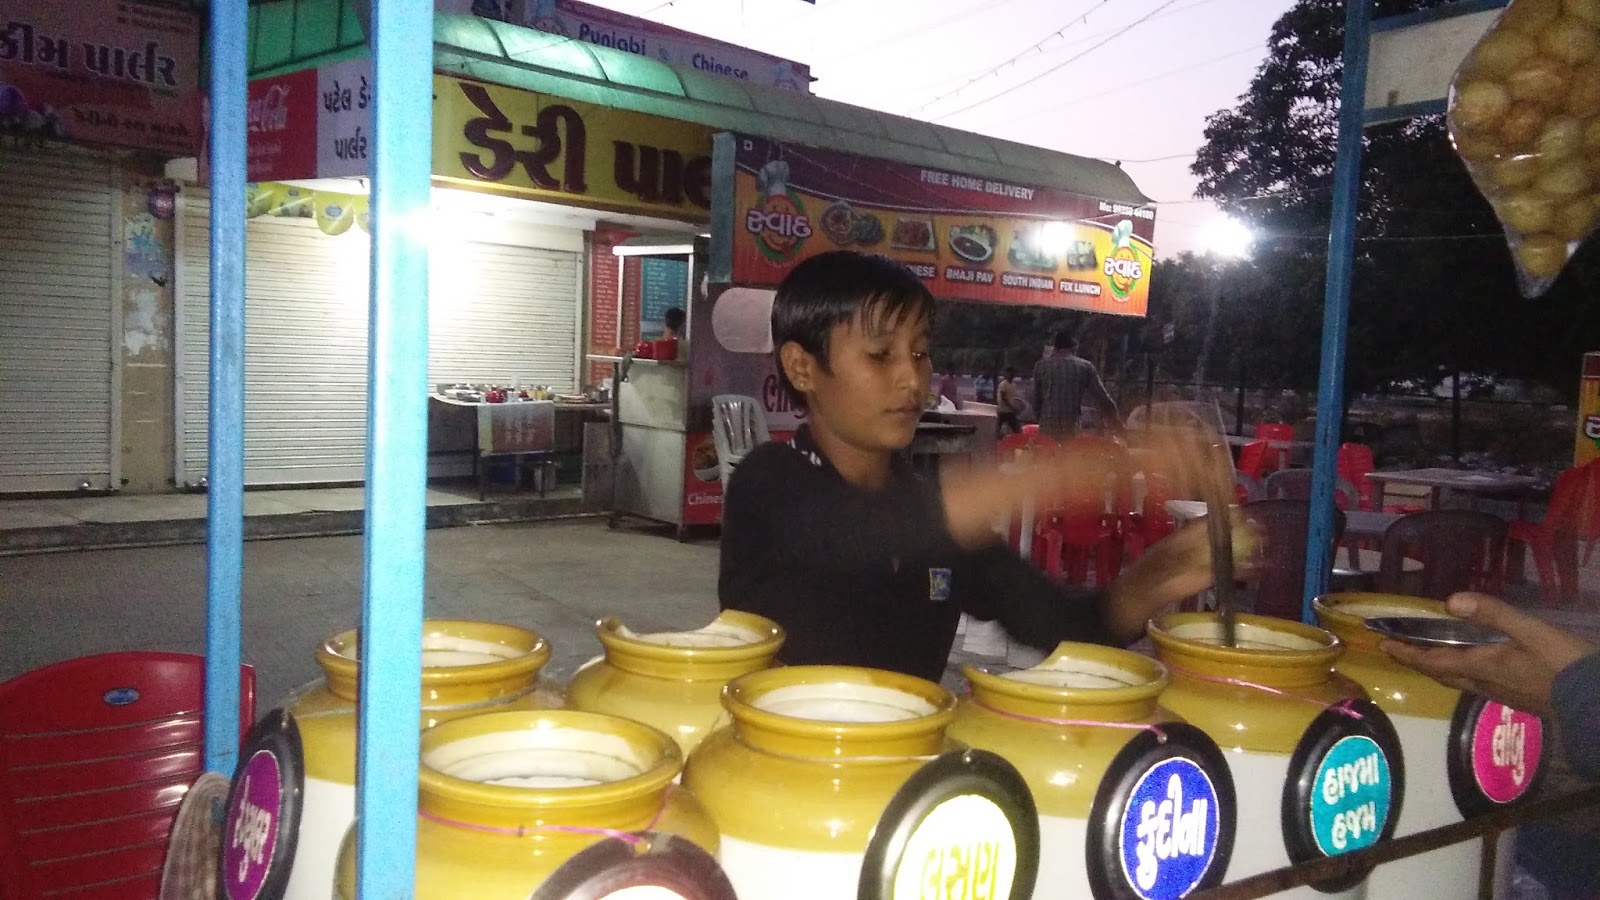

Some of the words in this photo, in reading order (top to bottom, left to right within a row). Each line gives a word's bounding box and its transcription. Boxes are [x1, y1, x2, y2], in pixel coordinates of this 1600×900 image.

[579, 23, 646, 55] Punjabi
[691, 52, 749, 80] Chinese
[322, 80, 352, 113] પટેલ
[458, 82, 588, 194] ડેરી
[920, 170, 948, 185] FREE
[951, 175, 983, 192] HOME
[985, 181, 1034, 200] DELIVERY
[946, 268, 974, 281] BHAJI
[975, 272, 994, 284] PAV
[1002, 274, 1028, 287] SOUTH
[1028, 277, 1054, 290] INDIAN
[1060, 281, 1074, 292] FIX
[1075, 282, 1101, 295] LUNCH
